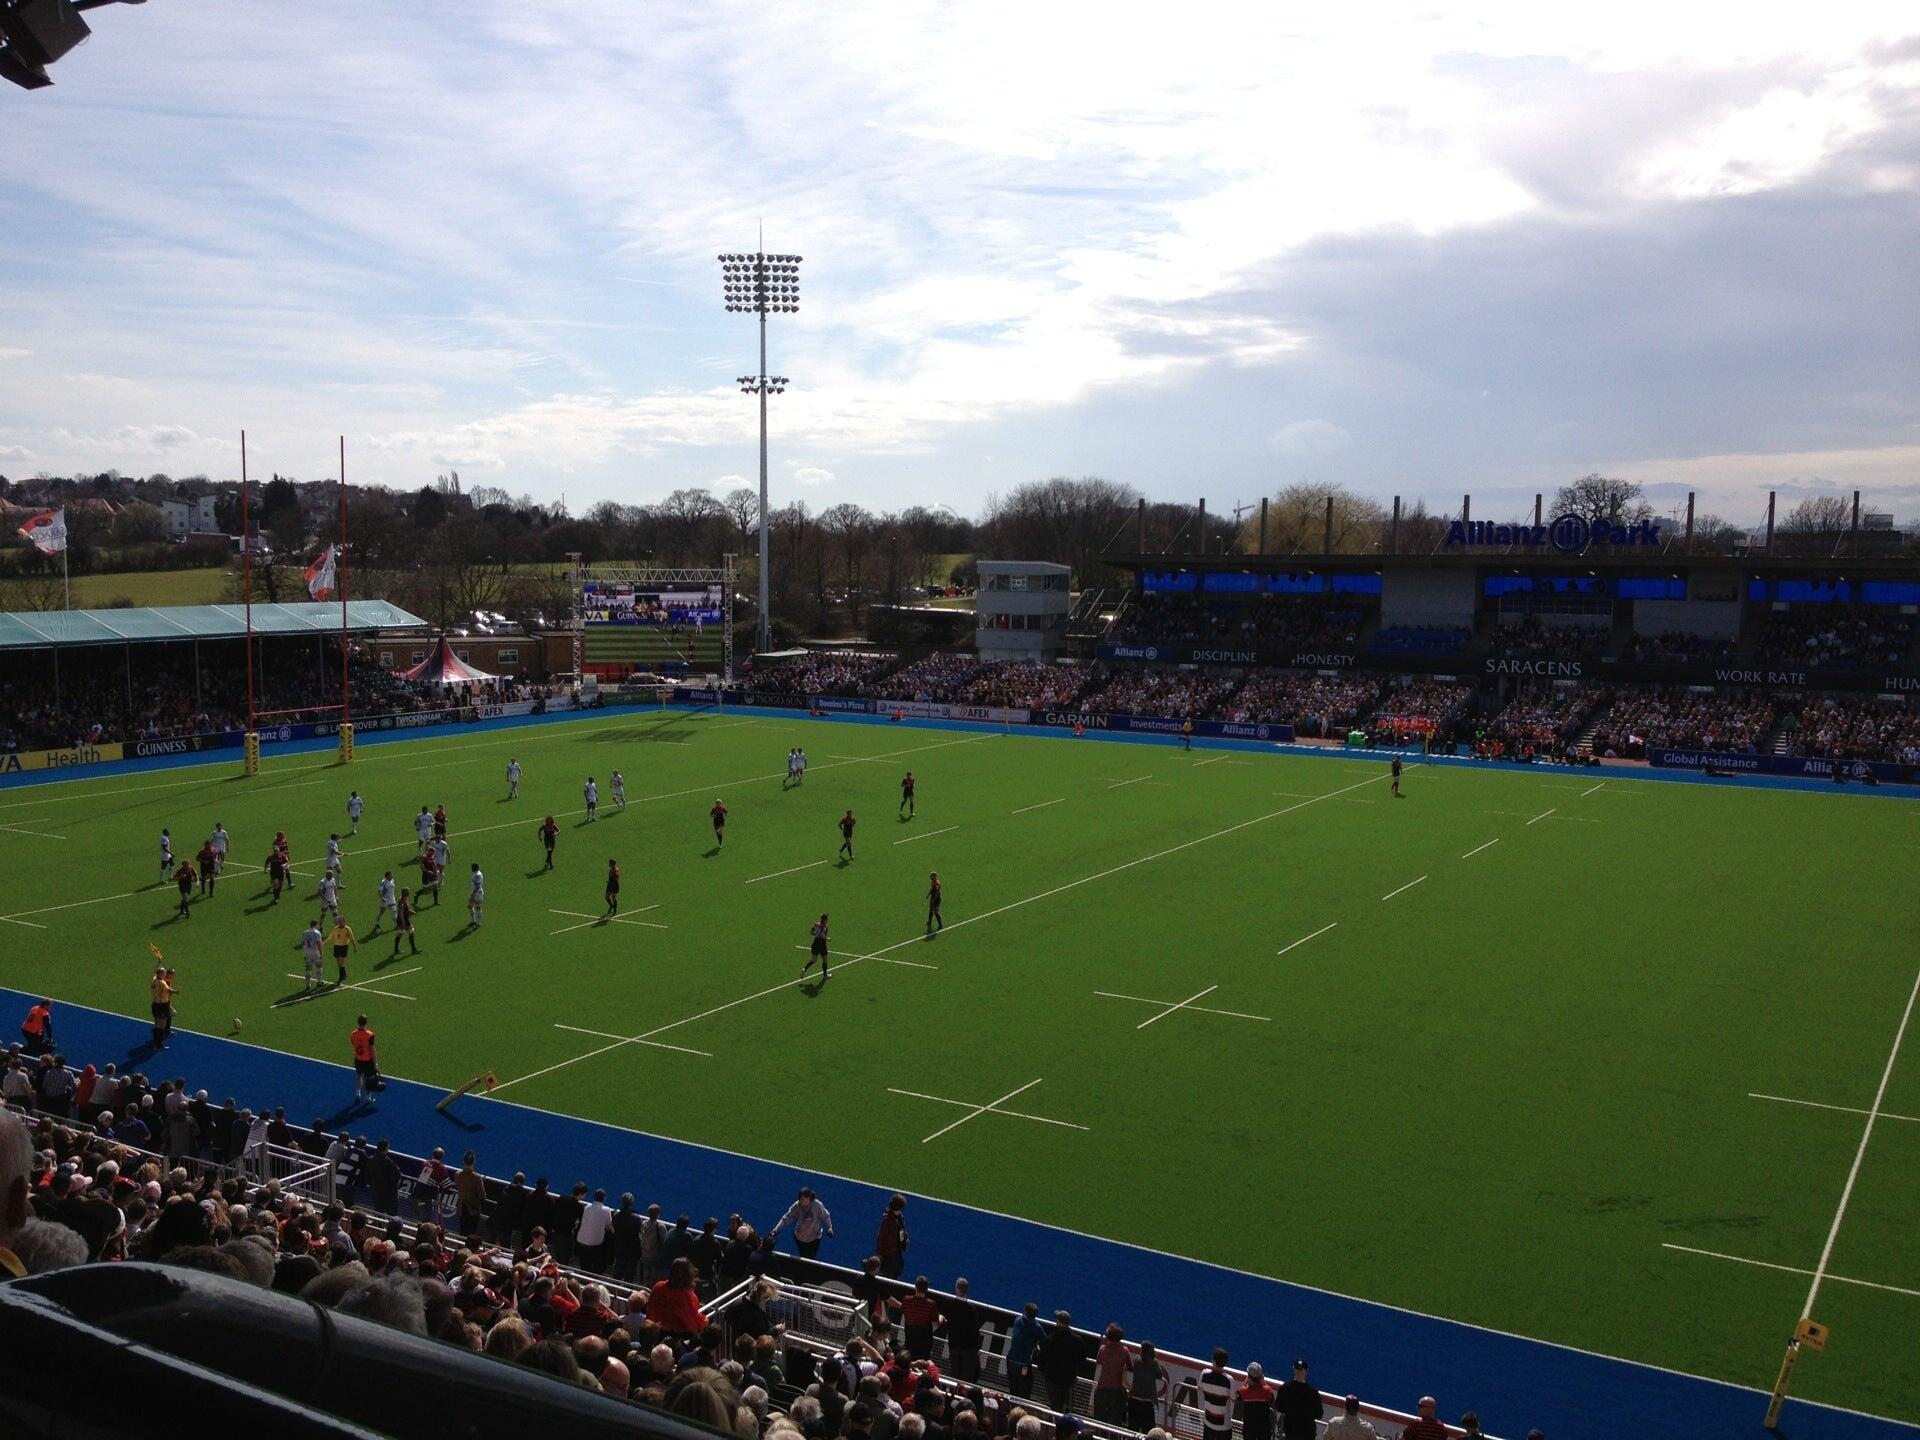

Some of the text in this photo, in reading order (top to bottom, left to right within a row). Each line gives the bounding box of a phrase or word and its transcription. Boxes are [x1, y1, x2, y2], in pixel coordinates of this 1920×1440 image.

[1448, 519, 1662, 546] Allianz Park
[1114, 648, 1144, 656] Allianz
[1193, 650, 1257, 662] DISCIPLINE
[1297, 654, 1356, 666] HONESTY
[1486, 659, 1582, 676] SARACENS
[1715, 669, 1806, 685] WORK RATE
[690, 691, 715, 700] Allianz
[819, 699, 865, 710] Domino's Pizza
[484, 706, 504, 717] AFEX
[968, 709, 990, 718] AFEX
[1046, 712, 1108, 728] GARMIN
[1222, 724, 1255, 736] Allianz
[137, 739, 187, 756] GUINNESS
[47, 748, 100, 768] Health
[1663, 753, 1698, 765] Global
[1803, 760, 1849, 775] Alliaz
